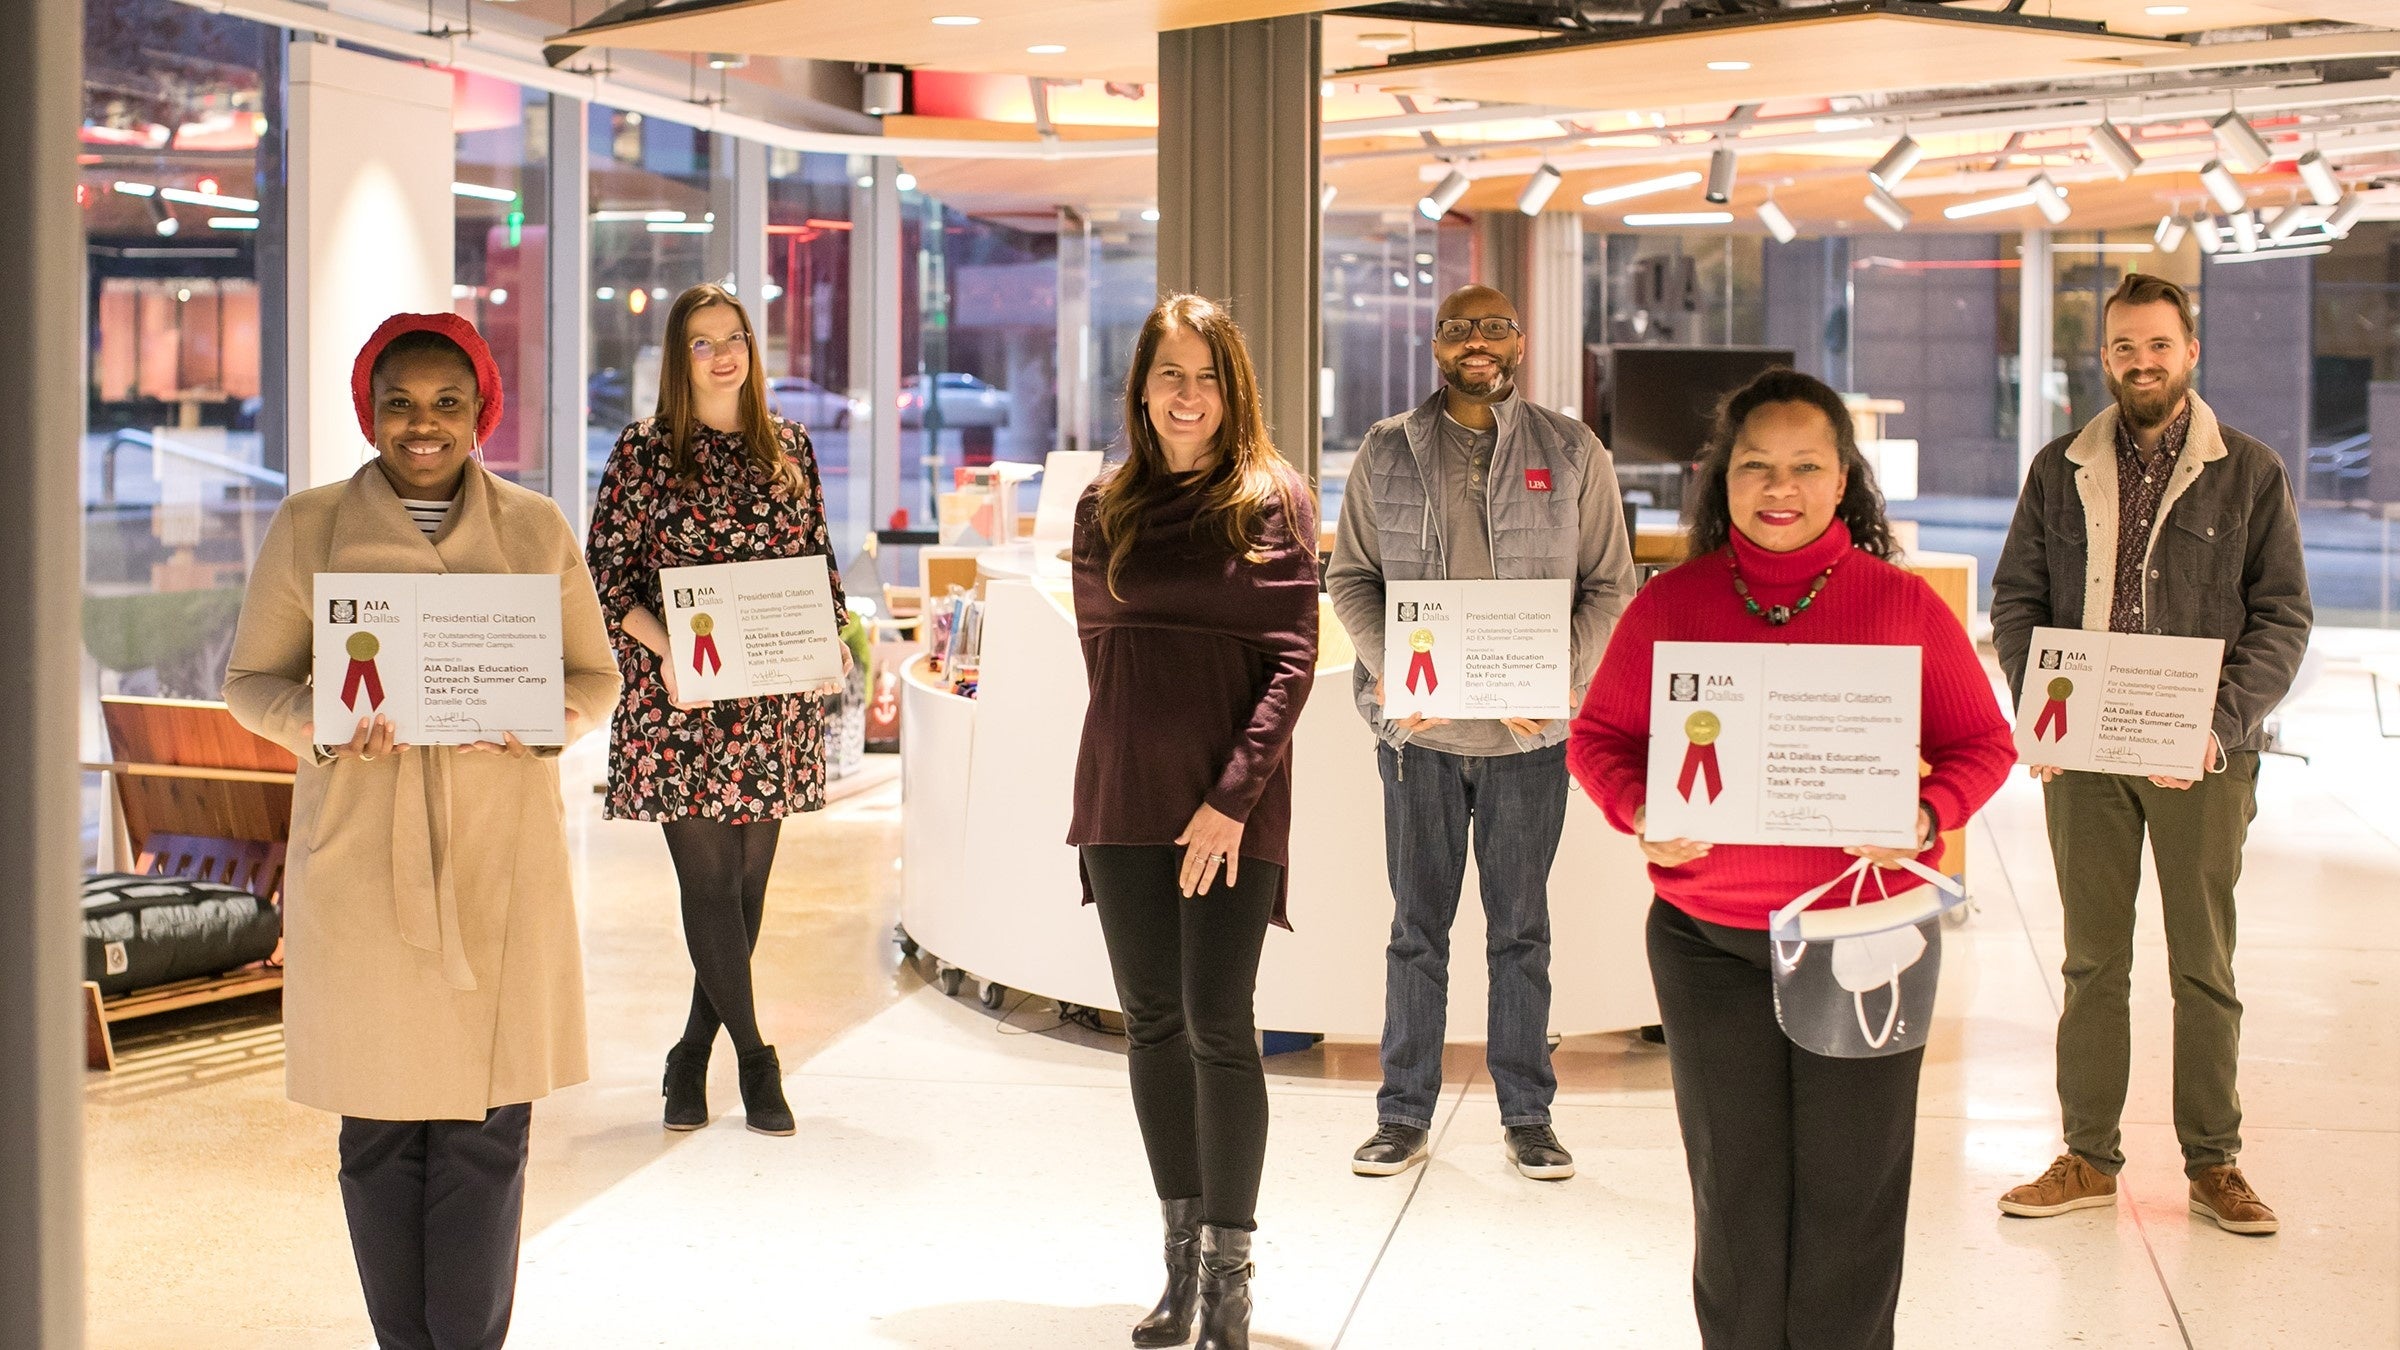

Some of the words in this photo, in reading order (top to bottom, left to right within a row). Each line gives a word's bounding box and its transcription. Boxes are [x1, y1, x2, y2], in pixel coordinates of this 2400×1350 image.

[1528, 480, 1547, 489] LPA
[696, 586, 715, 595] AIA
[737, 590, 782, 601] Presidential
[784, 587, 814, 597] Citation
[363, 600, 389, 610] AIA
[697, 595, 723, 606] Dallas
[750, 605, 782, 614] Outstanding
[782, 602, 816, 610] Contributions
[1422, 602, 1442, 610] AIA
[362, 612, 400, 623] Dallas
[422, 613, 489, 622] Presidential
[492, 613, 535, 622] Citation
[1422, 612, 1449, 621] Dallas
[1466, 612, 1515, 620] Presidential
[1518, 611, 1551, 619] Citation
[438, 632, 484, 640] Outstanding
[758, 631, 779, 639] Dallas
[780, 628, 814, 636] Education
[745, 640, 776, 649] Outreach
[778, 637, 806, 646] Summer
[807, 635, 827, 644] Camp
[2066, 651, 2087, 660] AIA
[424, 664, 441, 672] AIA
[444, 664, 475, 672] Dallas
[478, 664, 528, 672] Education
[2063, 661, 2093, 671] Dallas
[2109, 665, 2162, 676] Presidential
[2163, 668, 2199, 678] Citation
[424, 675, 470, 683] Outreach
[473, 675, 514, 683] Summer
[517, 675, 547, 684] Camp
[1706, 675, 1734, 686] AIA
[424, 686, 447, 694] Task
[450, 686, 479, 694] Force
[2119, 681, 2156, 689] Outstanding
[2156, 683, 2196, 691] Contributions
[1704, 689, 1744, 701] Dallas
[1768, 691, 1840, 702] Presidential
[1844, 692, 1892, 703] Citation
[424, 697, 462, 705] Danielle
[465, 697, 487, 705] Odis
[1784, 713, 1835, 723] Outstanding
[1837, 714, 1891, 722] Contributions
[2145, 709, 2185, 718] Education
[2101, 715, 2137, 724] Outreach
[2139, 718, 2172, 727] Summer
[2173, 721, 2197, 729] Camp
[1798, 724, 1833, 732] Summer
[2098, 733, 2126, 741] Michael
[2161, 737, 2176, 745] AIA
[1767, 751, 1786, 760] AIA
[1789, 752, 1822, 760] Dallas
[1826, 752, 1880, 762] Education
[1766, 764, 1816, 774] Outreach
[1819, 765, 1864, 775] Summer
[1868, 766, 1900, 777] Camp
[1766, 777, 1791, 786] Task
[1794, 778, 1825, 787] Force
